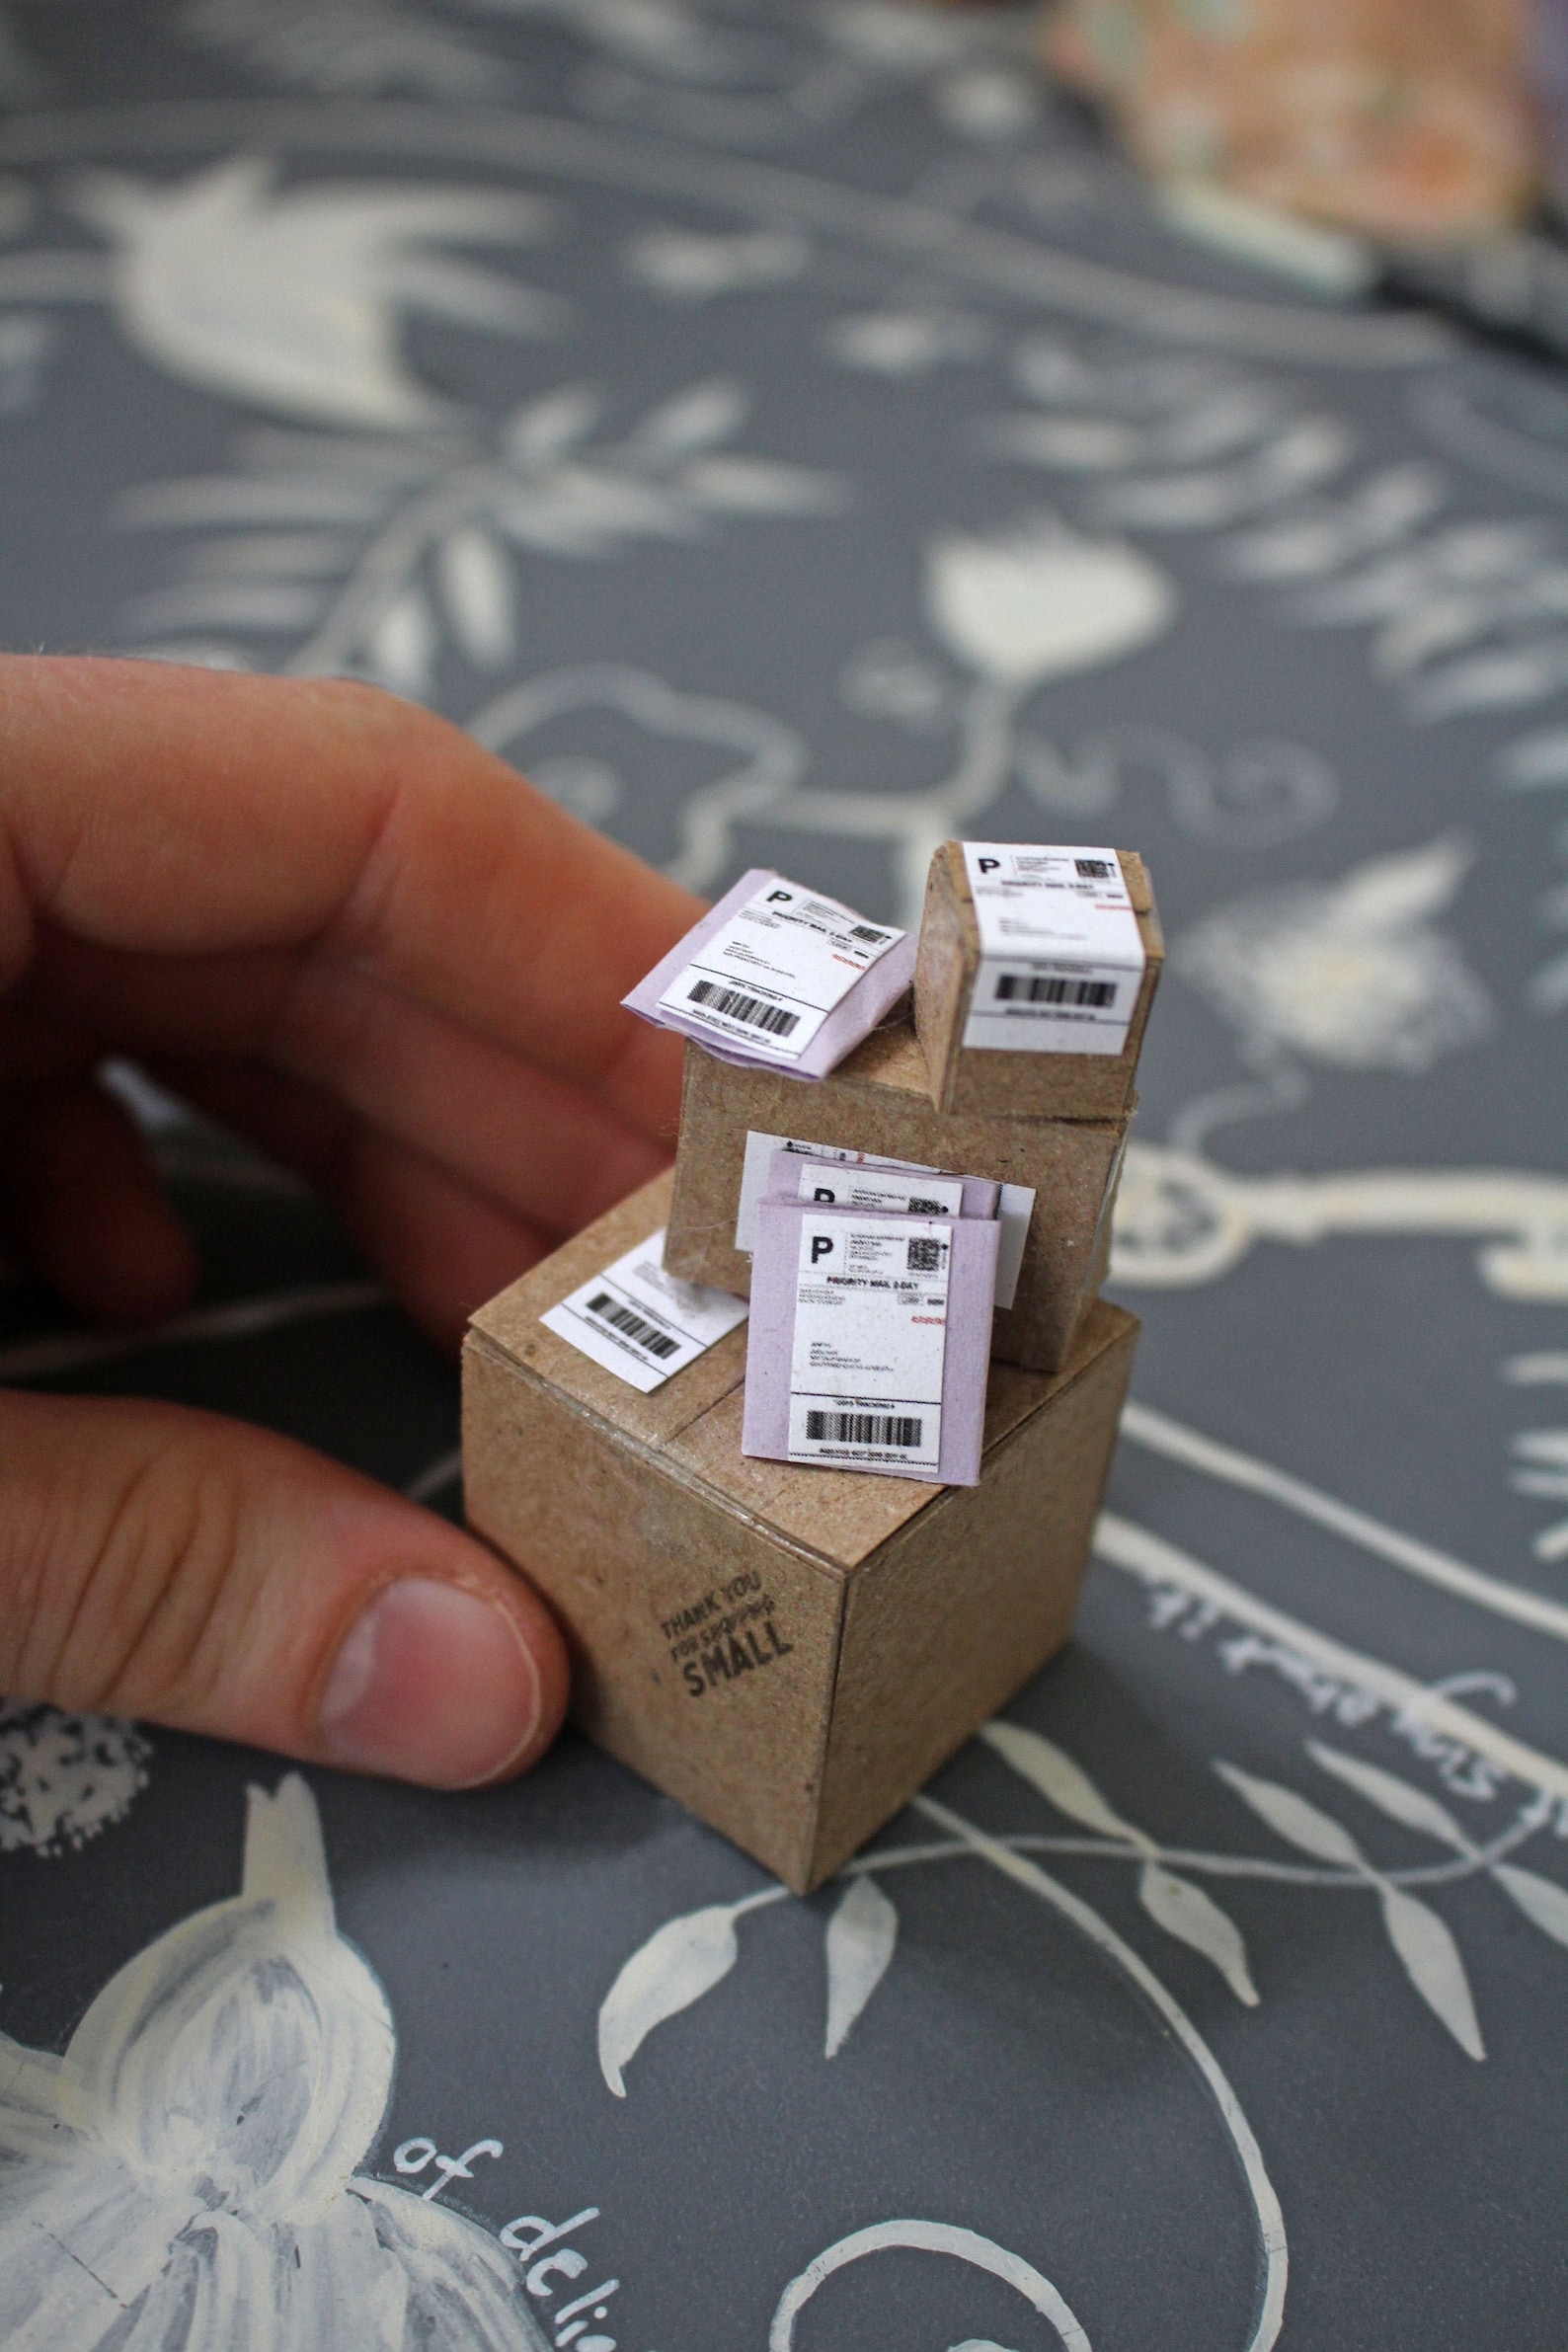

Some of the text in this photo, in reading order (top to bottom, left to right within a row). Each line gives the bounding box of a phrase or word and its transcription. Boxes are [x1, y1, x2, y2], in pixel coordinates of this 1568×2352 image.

[978, 858, 1000, 874] P
[766, 890, 793, 902] P
[811, 1235, 833, 1264] P
[661, 1570, 762, 1639] THANK YOU
[683, 1620, 794, 1697] SMALL
[394, 2137, 504, 2201] of
